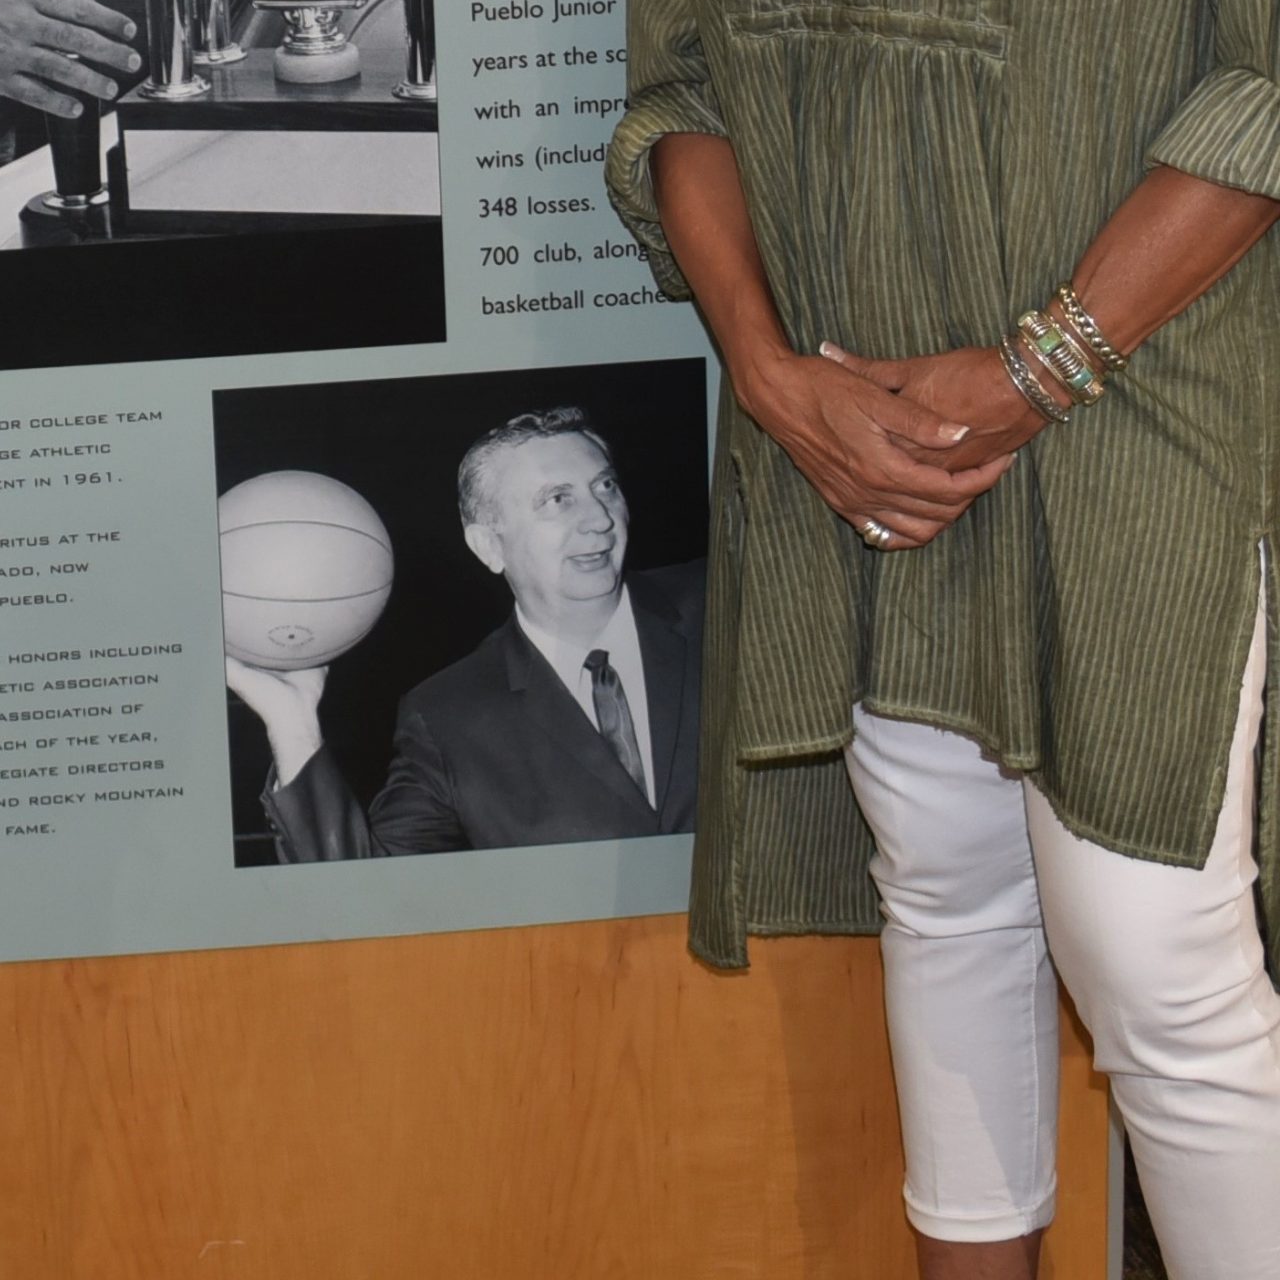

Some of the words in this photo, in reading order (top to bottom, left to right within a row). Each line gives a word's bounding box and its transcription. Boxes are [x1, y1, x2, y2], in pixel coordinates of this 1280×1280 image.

[471, 0, 545, 23] Pueblo
[475, 150, 525, 170] wins
[478, 196, 518, 219] 348
[527, 195, 596, 216] losses.
[479, 245, 520, 267] 700
[533, 241, 583, 264] club,
[481, 289, 585, 316] basketball
[29, 414, 108, 429] COLLEGE
[115, 410, 163, 423] TEAM
[34, 477, 52, 488] IN
[63, 471, 122, 486] 1961.
[49, 562, 89, 574] NOW
[8, 650, 82, 665] HONORS
[89, 643, 183, 659] INCLUDING
[42, 674, 159, 691] ASSOCIATION
[35, 737, 58, 749] OF
[66, 735, 100, 746] THE
[107, 731, 158, 744] YEAR,
[67, 759, 165, 776] DIRECTORS
[5, 823, 56, 836] FAME.
